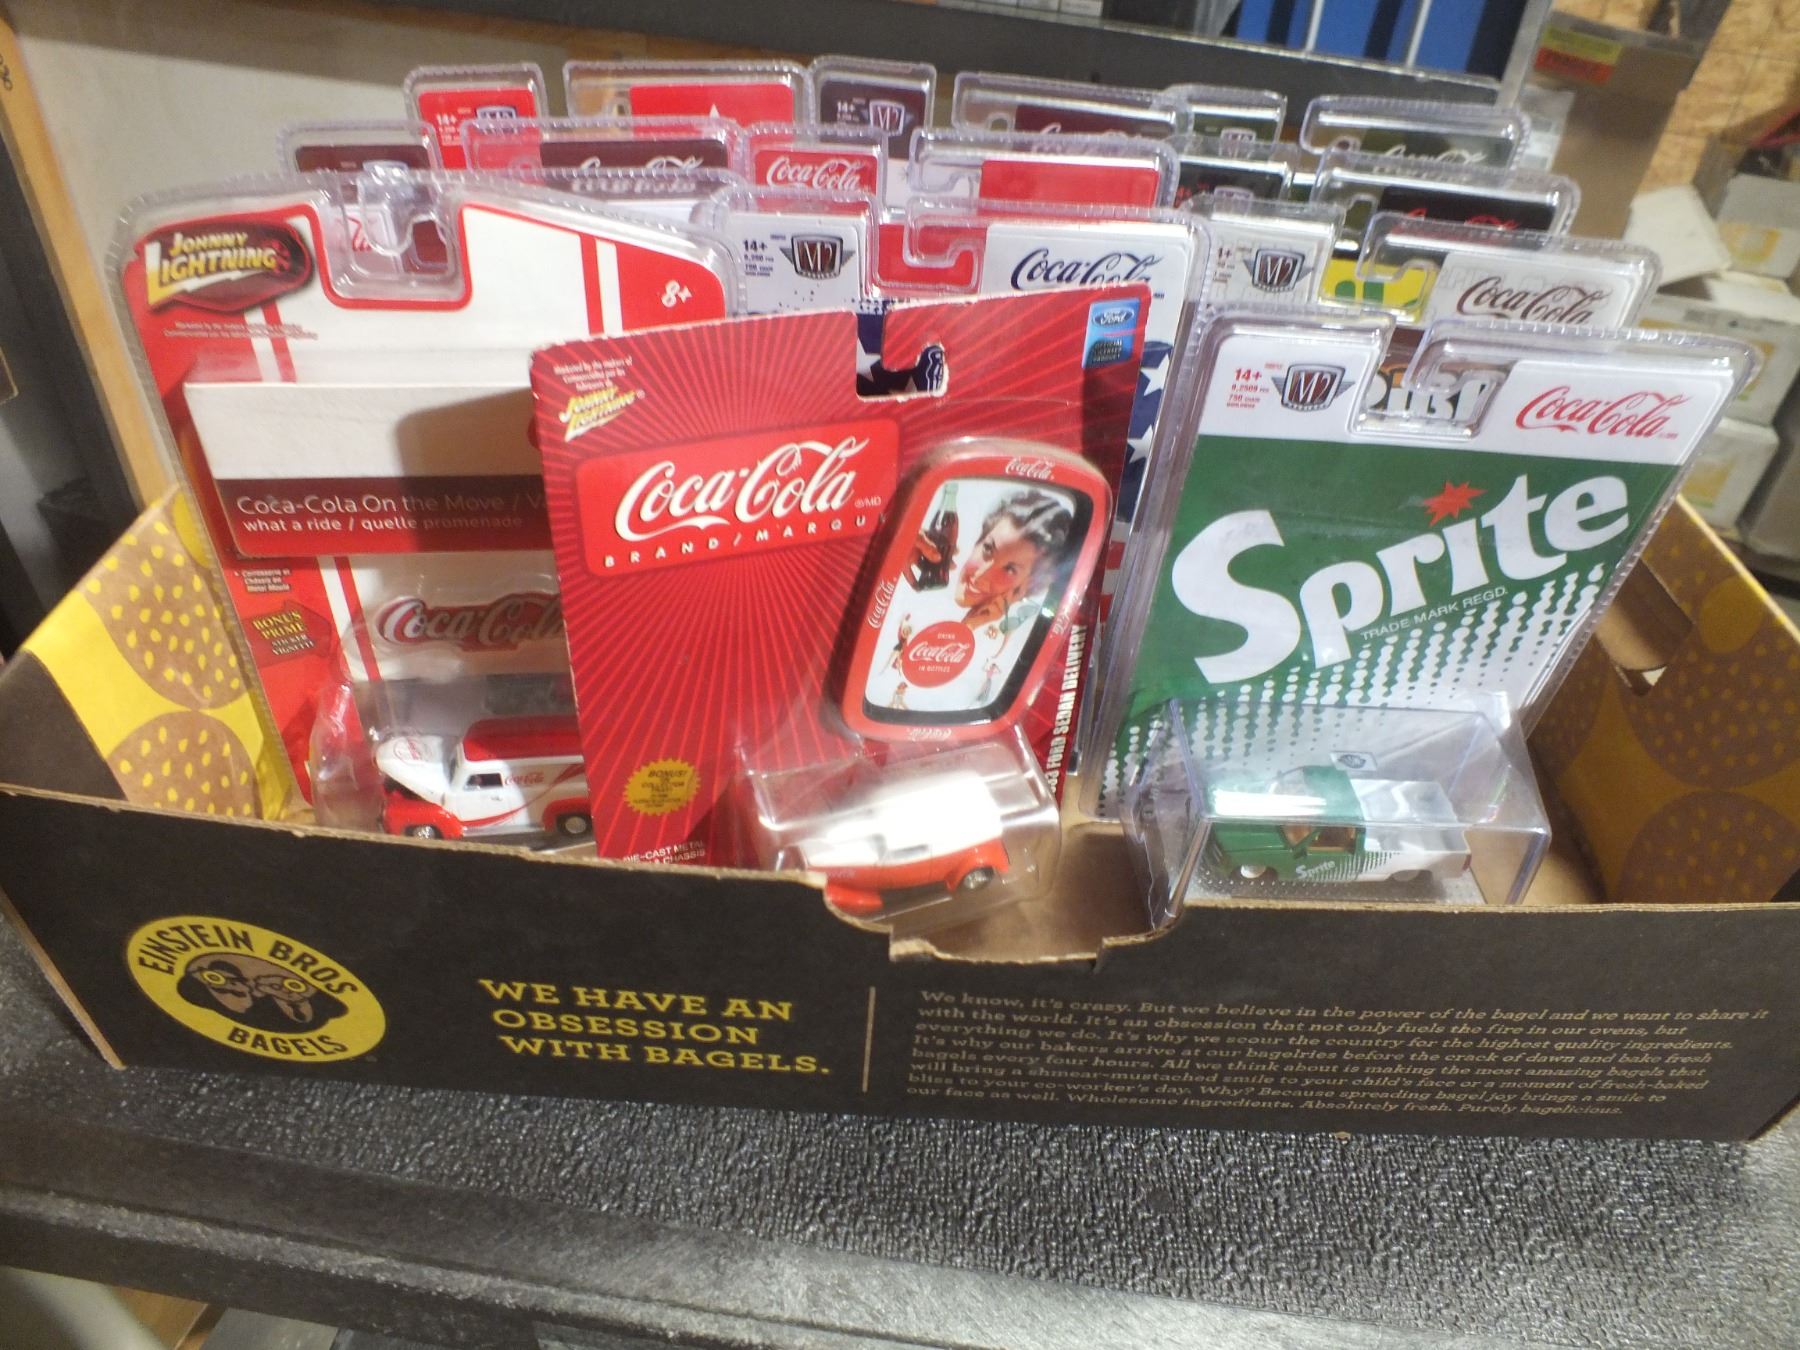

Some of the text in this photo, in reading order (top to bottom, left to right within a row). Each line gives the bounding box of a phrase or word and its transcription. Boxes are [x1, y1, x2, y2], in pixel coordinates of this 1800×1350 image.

[767, 156, 864, 190] Coca-Cola
[743, 239, 768, 252] 14+
[144, 241, 278, 305] LIGHTNING
[662, 279, 692, 307] 8+
[1456, 277, 1612, 324] Coca-Cola
[1235, 367, 1262, 382] 14+
[1516, 386, 1691, 437] Coca-Cola
[1005, 457, 1054, 481] Coca-Cola
[237, 493, 505, 515] Coca-Cola On the Move
[615, 436, 870, 542] Coca-Cola
[244, 516, 287, 532] what
[292, 520, 303, 531] a
[307, 516, 342, 531] ride
[361, 517, 417, 533] quelle
[423, 515, 524, 533] promenade
[1173, 474, 1630, 685] Sprite
[1360, 585, 1508, 640] TRADE MARK REGD.
[908, 641, 970, 663] Coca-Cola
[1046, 624, 1088, 769] FORD SEDAN DELIVERY
[139, 924, 359, 999] EINSTEIN BROS
[478, 979, 793, 1022] WE HAVE AN
[922, 991, 955, 1002] We
[1031, 998, 1063, 1009] it's
[1139, 1002, 1176, 1013] But
[1216, 1004, 1292, 1016] believe
[1323, 1006, 1356, 1017] the
[1358, 1009, 1424, 1020] power
[1455, 1008, 1486, 1019] the
[1491, 1009, 1548, 1021] bagel
[1549, 1009, 1590, 1020] and
[1624, 1011, 1670, 1020] want
[1696, 1009, 1750, 1020] share
[491, 1009, 759, 1046] OBSESSION
[918, 1008, 965, 1018] with
[972, 1008, 1006, 1020] the
[1085, 1015, 1117, 1026] It's
[1154, 1017, 1257, 1030] obsession
[1263, 1020, 1304, 1031] that
[1309, 1023, 1344, 1031] not
[1348, 1022, 1393, 1035] only
[1396, 1022, 1446, 1033] fuels
[1450, 1023, 1482, 1034] the
[1485, 1023, 1524, 1034] fire
[1552, 1027, 1587, 1035] our
[1654, 1025, 1688, 1035] but
[227, 1027, 349, 1057] BAGELS
[914, 1034, 1712, 1063] It's why our bakers arrive our bagelries before the crack dawn and bake fresh
[915, 1023, 1031, 1038] everything
[1108, 1030, 1140, 1041] It's
[1146, 1031, 1187, 1044] why
[1226, 1036, 1284, 1044] scour
[1288, 1035, 1320, 1045] the
[1325, 1038, 1405, 1049] country
[1407, 1037, 1438, 1048] for
[1442, 1038, 1473, 1048] the
[1476, 1038, 1551, 1050] highest
[1554, 1039, 1620, 1051] quality
[499, 1035, 831, 1075] WITH BAGELS.
[912, 1047, 977, 1060] bagels
[982, 1054, 1040, 1065] every
[1046, 1054, 1088, 1065] four
[1160, 1059, 1190, 1069] All
[1227, 1061, 1279, 1071] think
[1283, 1062, 1339, 1072] about
[1364, 1064, 1436, 1076] making
[1441, 1065, 1471, 1075] the
[1475, 1067, 1522, 1076] most
[1525, 1067, 1603, 1078] amazing
[1607, 1066, 1665, 1078] bagels
[1669, 1067, 1706, 1077] that
[908, 1072, 953, 1084] bliss
[984, 1079, 1029, 1087] your
[1034, 1081, 1150, 1093] co-worker's
[1200, 1085, 1255, 1097] Why?
[1258, 1087, 1335, 1097] Because
[1339, 1089, 1432, 1100] spreading
[1435, 1090, 1486, 1101] bagel
[1485, 1093, 1519, 1102] joy
[1520, 1091, 1578, 1102] brings
[1595, 1092, 1645, 1102] smile
[911, 1062, 1709, 1090] will bring shmear-mustached smile your child's face moment fresh-baked
[907, 1087, 940, 1096] our
[946, 1087, 984, 1097] face
[1067, 1093, 1178, 1105] Wholesome
[1299, 1099, 1399, 1112] Absolutely
[1458, 1103, 1517, 1115] Purely
